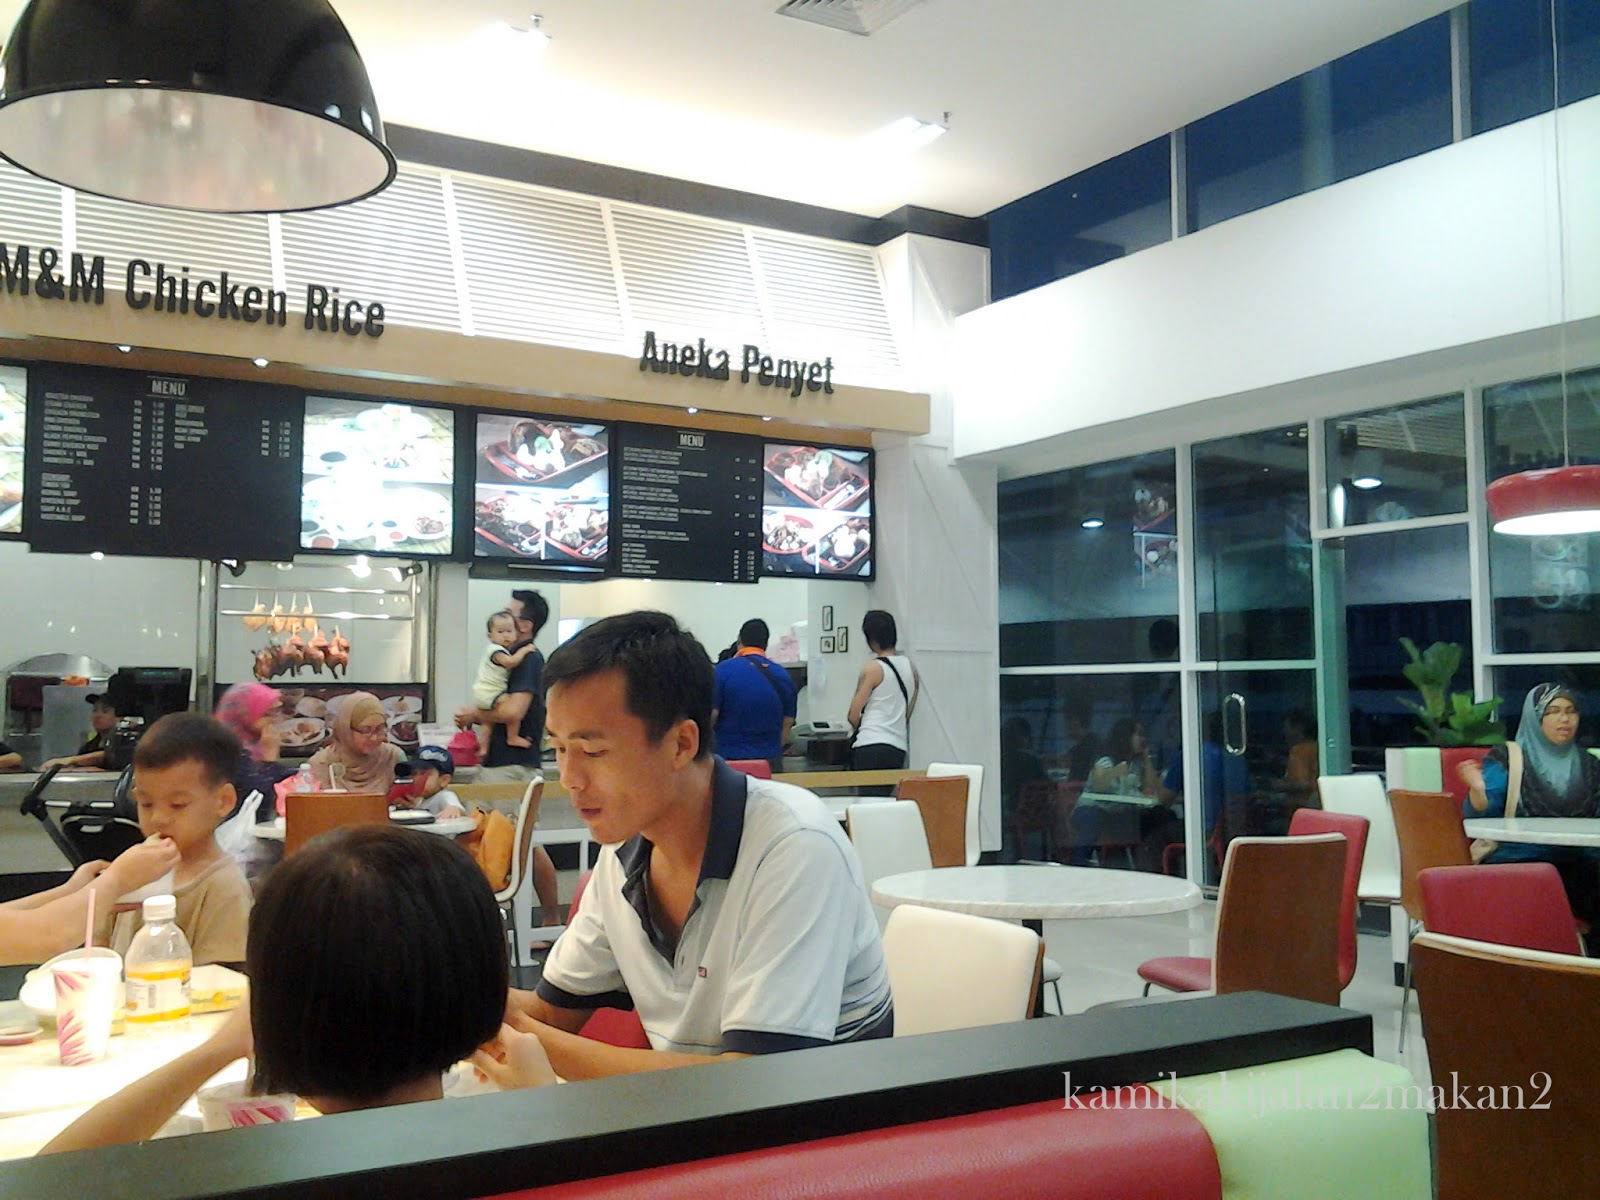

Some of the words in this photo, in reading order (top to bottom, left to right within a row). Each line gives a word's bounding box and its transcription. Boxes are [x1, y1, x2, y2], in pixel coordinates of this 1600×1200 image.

[0, 242, 105, 305] M&M
[125, 259, 287, 327] Chicken
[304, 283, 384, 338] Rice
[639, 331, 729, 381] Aneka
[741, 344, 834, 397] Penyet
[151, 380, 186, 396] MENU
[680, 433, 704, 447] MENU
